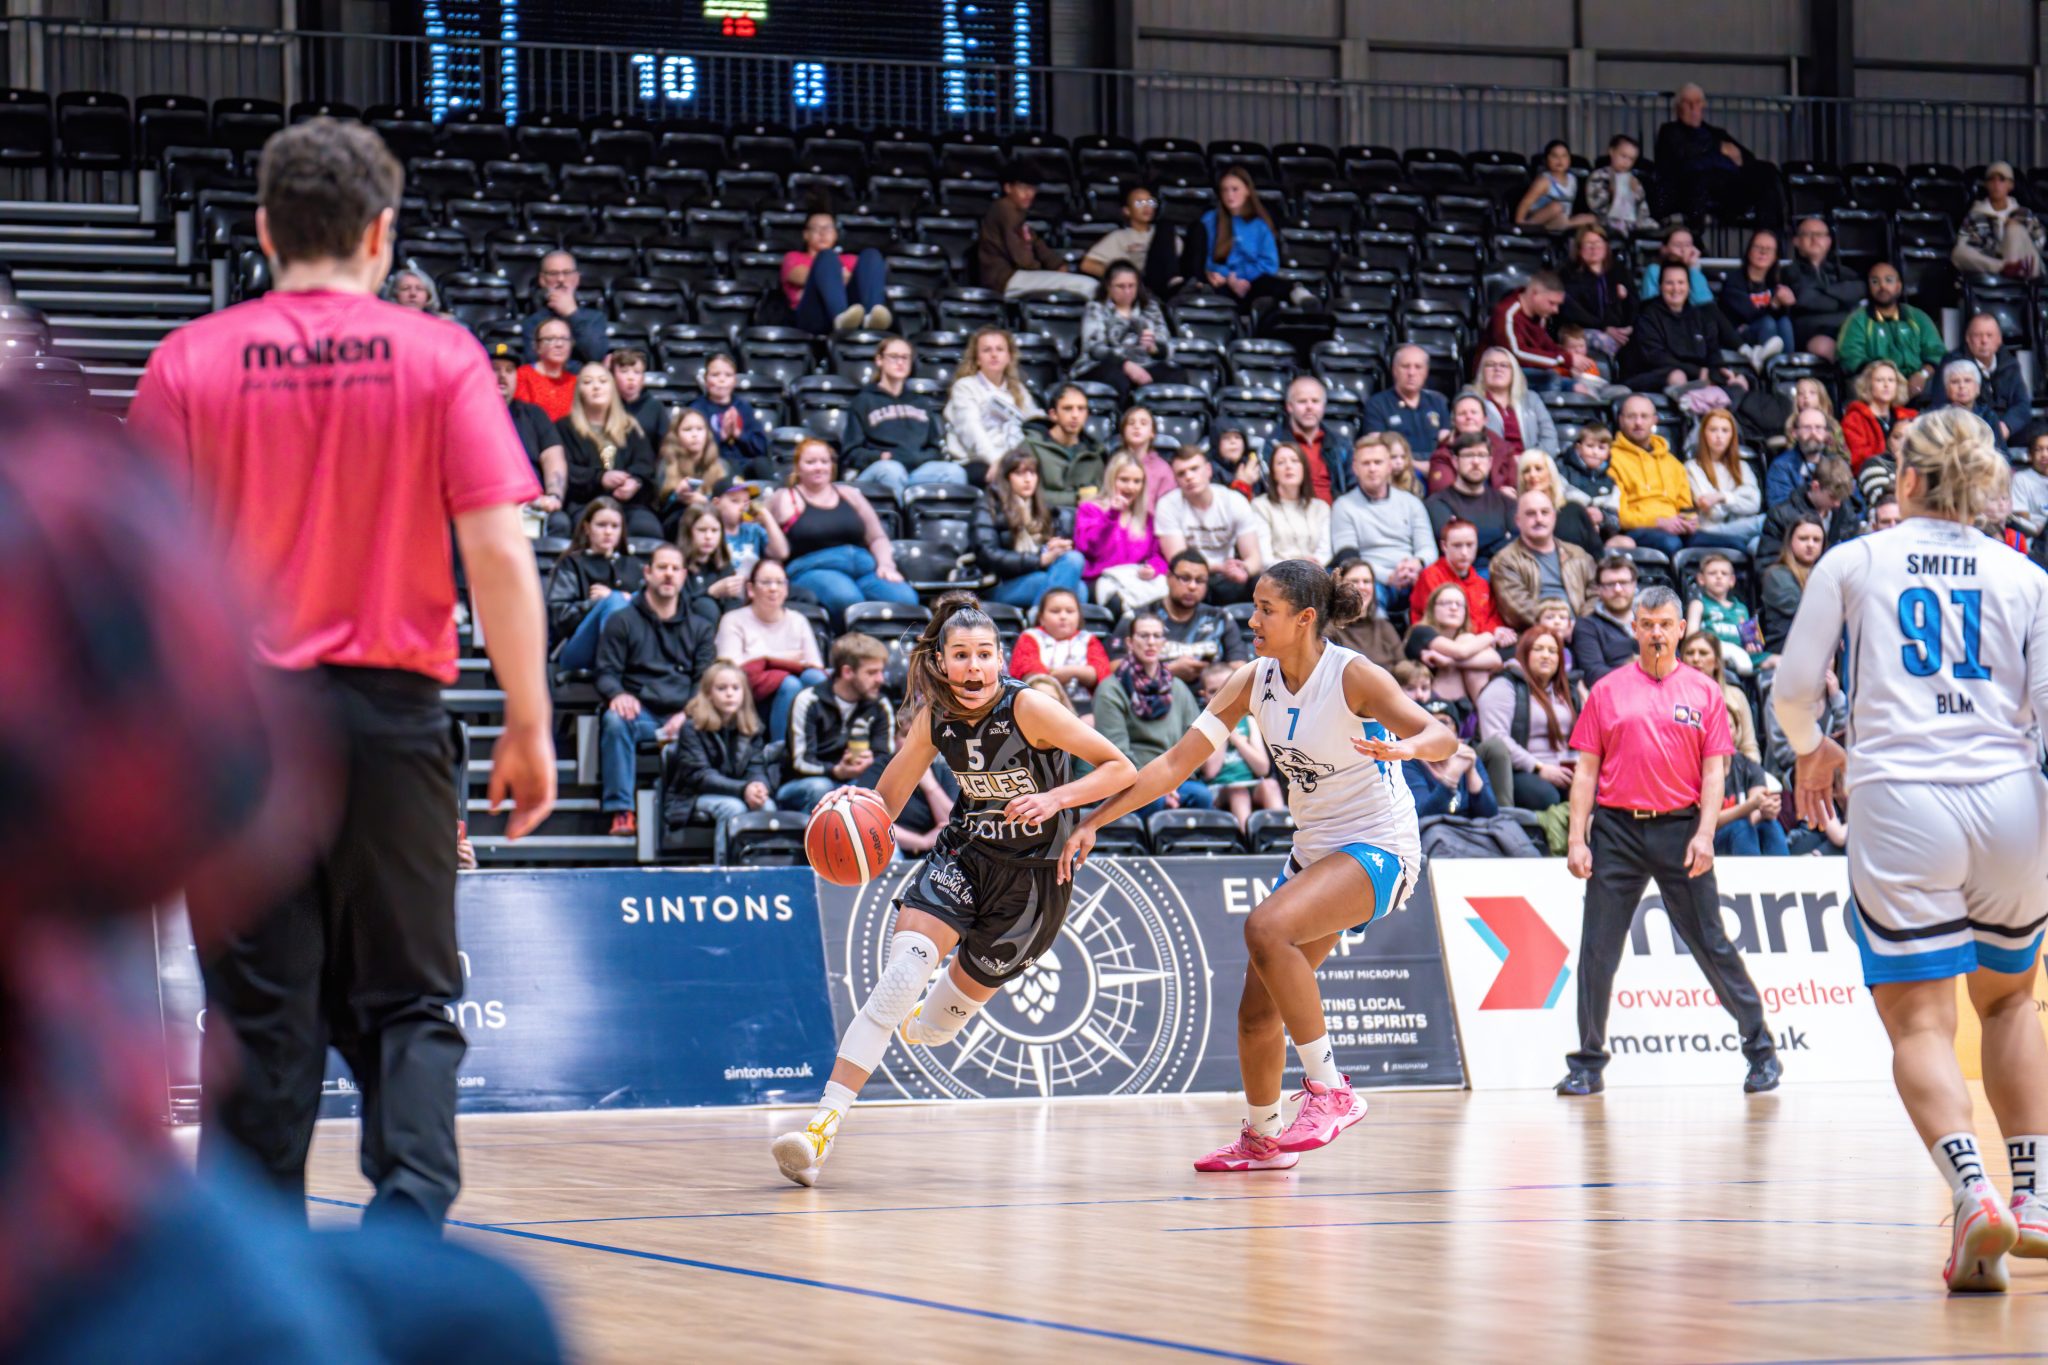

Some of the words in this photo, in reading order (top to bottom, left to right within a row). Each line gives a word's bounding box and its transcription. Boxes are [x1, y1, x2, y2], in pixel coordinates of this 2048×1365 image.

[244, 336, 391, 369] molten
[1907, 554, 1977, 575] SMITH
[1898, 586, 1992, 680] 91
[1937, 693, 1974, 714] BLM
[1287, 707, 1300, 741] 7
[965, 738, 985, 771] 5
[954, 769, 1037, 799] AGLES
[929, 869, 961, 895] ENIGMA
[620, 894, 793, 924] SINTONS
[1328, 970, 1354, 980] FIRST
[1357, 969, 1410, 980] MICROPUB
[1359, 998, 1405, 1011] LOCAL
[1611, 987, 1722, 1009] orward
[1758, 979, 1857, 1013] gether
[1362, 1013, 1428, 1030] SPIRITS
[1357, 1032, 1418, 1045] HERITAGE
[1609, 1026, 1811, 1054] marra.cuk
[724, 1062, 814, 1081] sintons.co.uk
